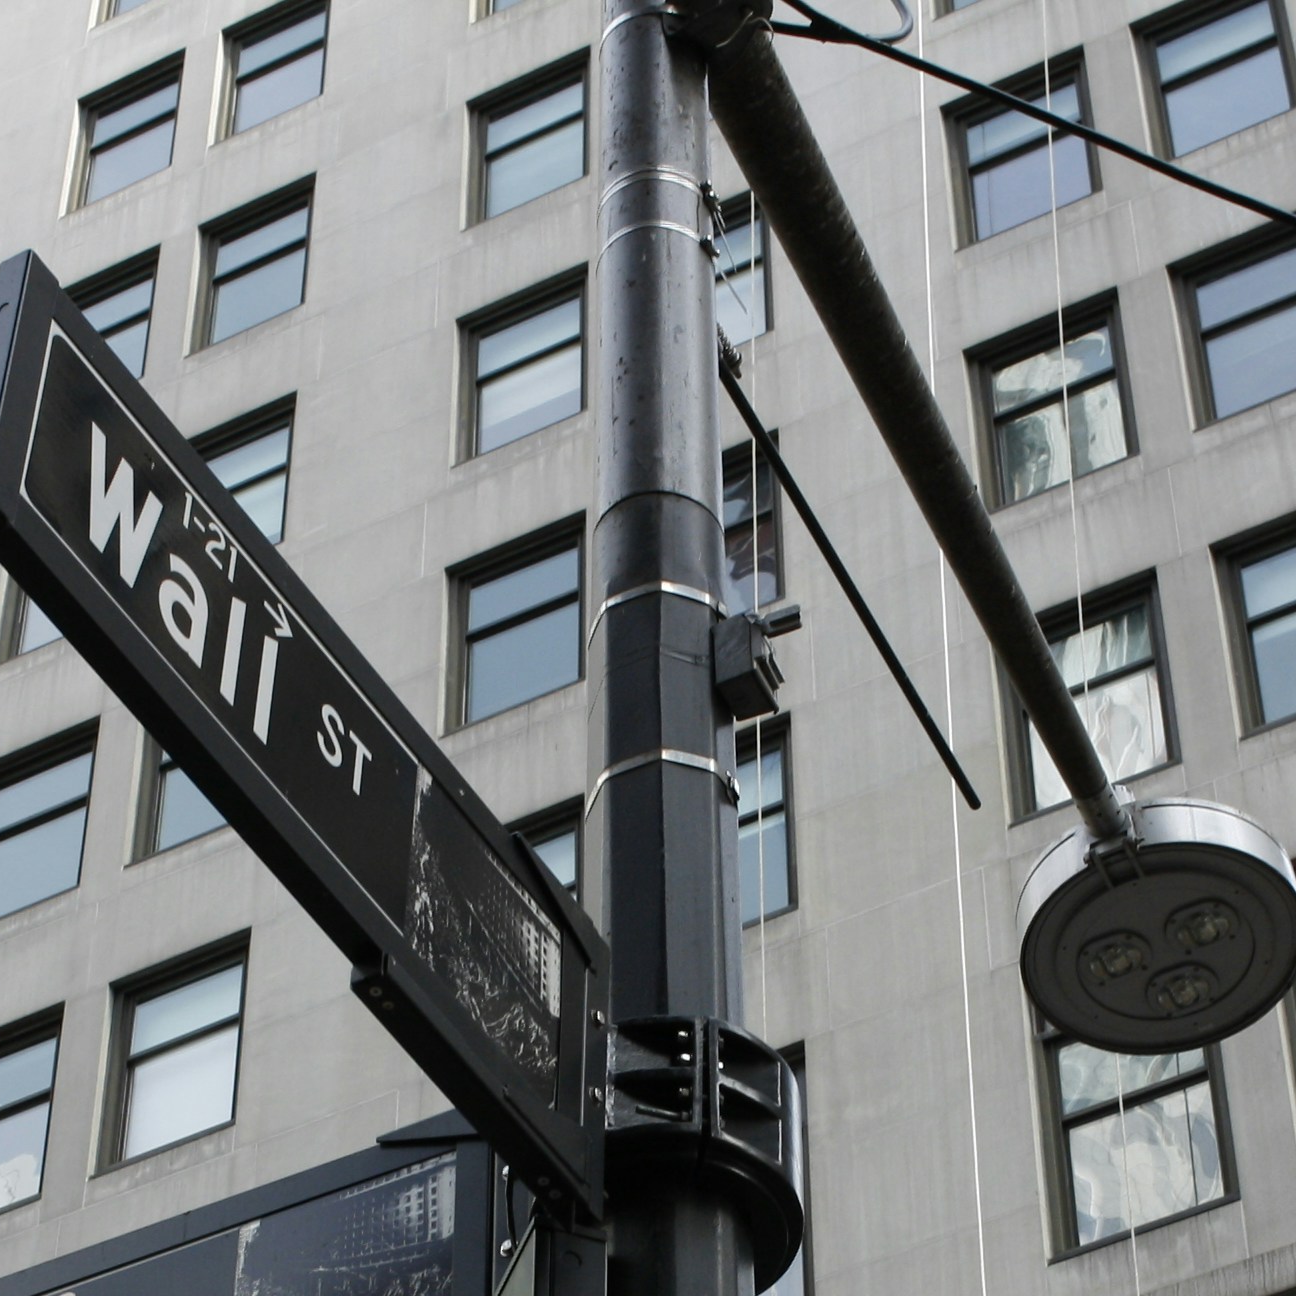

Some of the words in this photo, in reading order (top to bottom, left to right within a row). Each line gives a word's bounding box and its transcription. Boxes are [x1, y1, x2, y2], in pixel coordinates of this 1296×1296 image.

[89, 421, 279, 745] Wall
[317, 704, 372, 796] ST
[183, 491, 237, 583] 1-21
